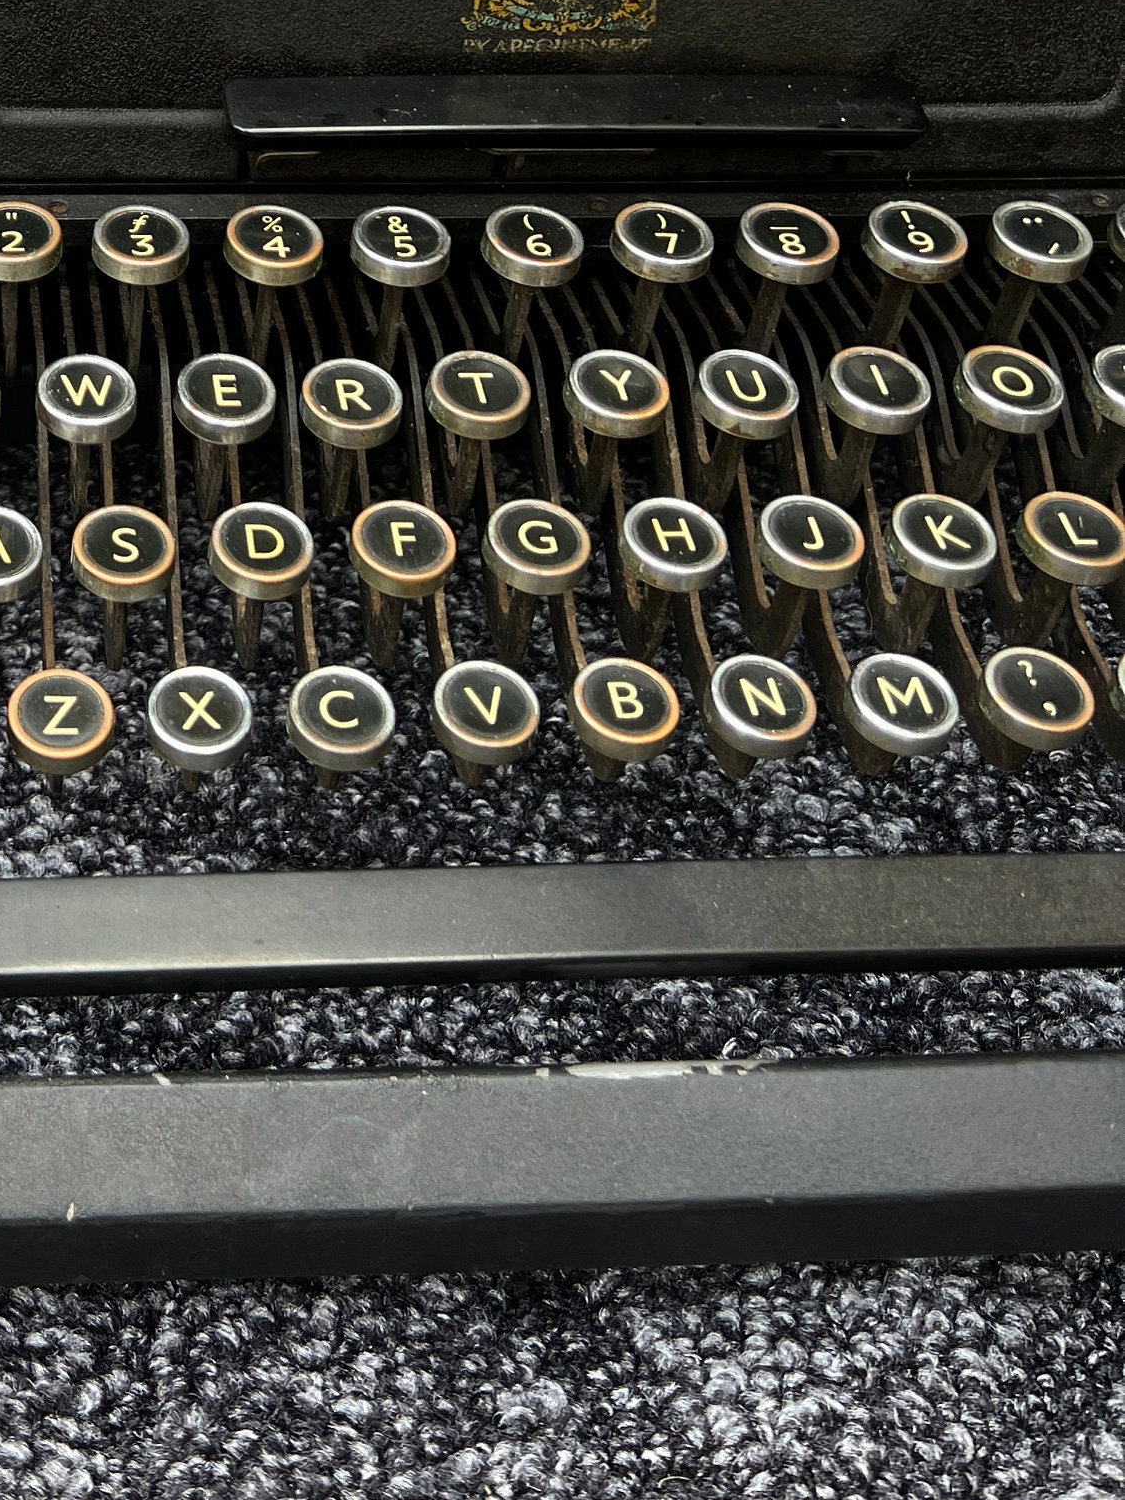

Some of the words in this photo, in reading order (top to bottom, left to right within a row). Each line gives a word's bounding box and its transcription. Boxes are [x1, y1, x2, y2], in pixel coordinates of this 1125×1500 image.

[1, 230, 26, 253] 2
[129, 234, 156, 257] 3
[262, 236, 291, 260] 4
[393, 235, 418, 261] 5
[525, 235, 553, 260] 6
[654, 232, 679, 255] 7
[777, 232, 807, 256] 8
[906, 231, 935, 255] 9
[60, 374, 113, 407] W
[211, 374, 242, 407] E
[334, 378, 372, 411] R
[457, 372, 494, 404] T
[598, 369, 632, 401] Y
[725, 369, 767, 402] U
[870, 364, 889, 396] I
[991, 365, 1035, 397] O
[111, 527, 140, 563] S
[244, 523, 285, 560] D
[390, 521, 417, 557] F
[517, 520, 559, 555] G
[651, 517, 697, 553] H
[802, 516, 825, 550] J
[925, 514, 973, 550] K
[1057, 511, 1099, 548] L
[178, 690, 222, 731] X
[318, 689, 359, 729] C
[463, 685, 502, 725] V
[606, 681, 644, 720] B
[739, 677, 787, 717] N
[877, 677, 935, 716] M
[42, 695, 80, 736] Z
